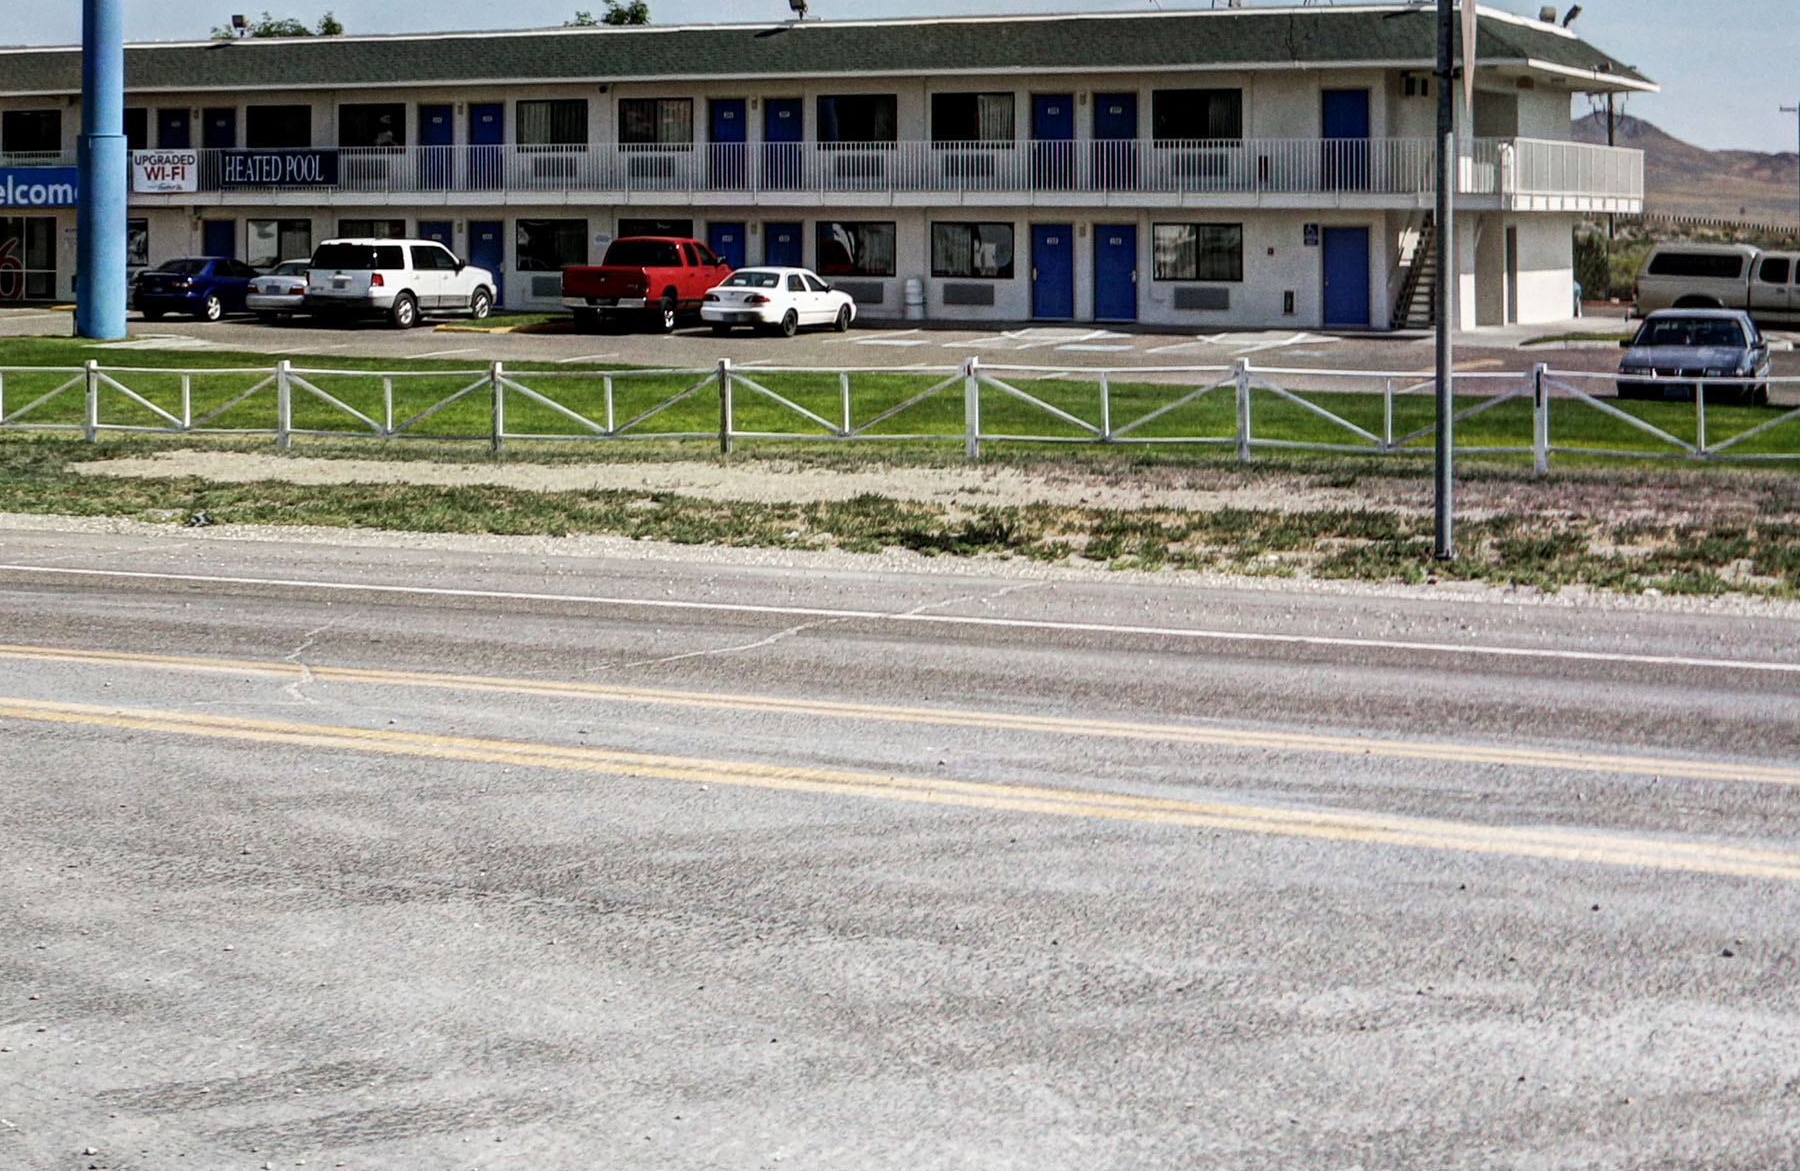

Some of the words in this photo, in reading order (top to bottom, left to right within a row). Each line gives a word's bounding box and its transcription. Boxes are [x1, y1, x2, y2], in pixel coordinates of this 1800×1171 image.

[134, 154, 196, 166] UPGRADED
[225, 155, 282, 182] HEATED
[285, 154, 325, 182] POOL
[144, 165, 185, 181] WI-FI
